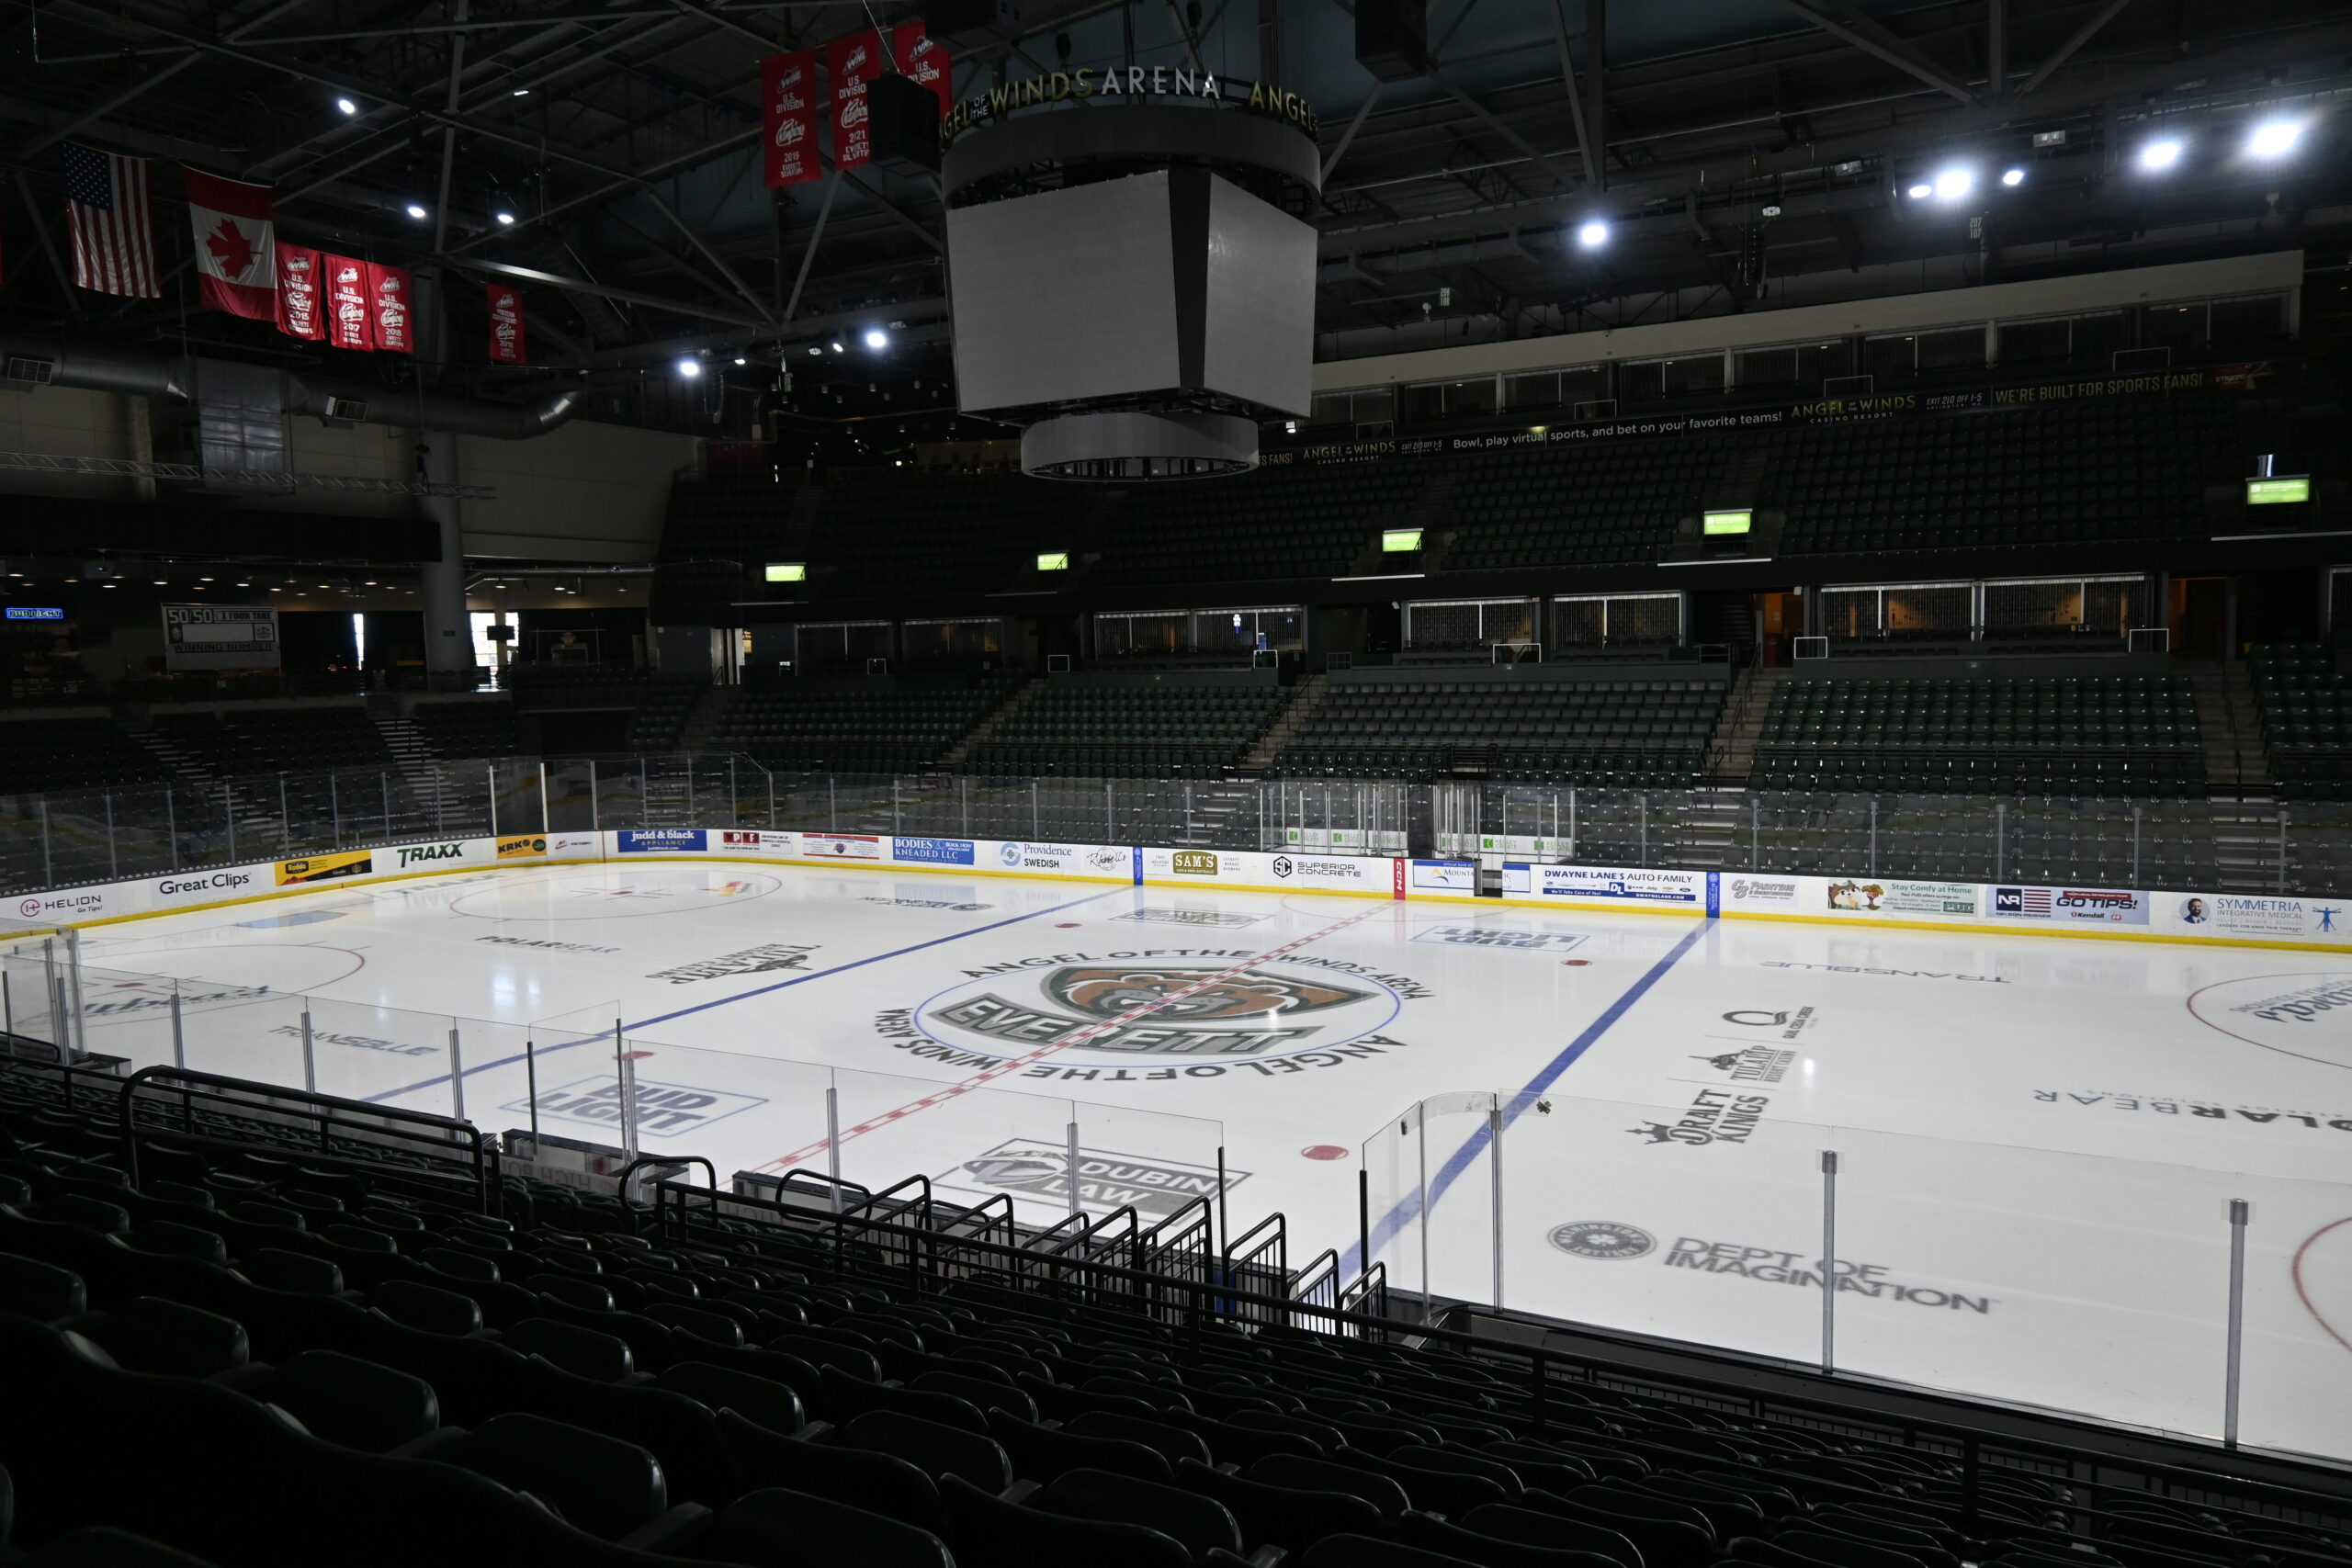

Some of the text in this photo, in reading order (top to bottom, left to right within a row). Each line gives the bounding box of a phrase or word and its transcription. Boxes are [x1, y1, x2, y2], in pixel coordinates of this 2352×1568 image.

[838, 83, 867, 99] DIVISIO
[972, 65, 1221, 119] OF THE WINDS ARENA
[776, 98, 804, 114] DIVISION
[784, 151, 799, 163] 2019
[335, 292, 364, 304] DIVISION
[379, 299, 405, 311] DIVISION
[343, 322, 360, 332] 2017
[1996, 386, 2036, 404] WE'RE
[2040, 383, 2075, 400] BUILT
[2078, 380, 2104, 396] FOR
[2108, 376, 2160, 395] SPORTS
[2163, 372, 2204, 390] FANS!
[1792, 395, 1917, 419] ANGEL WINDS
[1853, 412, 1894, 420] RESORT
[1453, 411, 1782, 449] Bowl, play virtual sports, and bet on your favorite teams!
[1303, 444, 1344, 461] ANGEL
[1353, 440, 1396, 457] WINDS
[168, 608, 213, 625] 50/50
[173, 642, 272, 653] WINNING NUMBER
[631, 829, 695, 841] judd & black
[895, 838, 933, 850] BODIES
[1023, 843, 1072, 856] Providence
[396, 840, 465, 868] TRAXX
[895, 849, 939, 858] KNEADED
[941, 851, 958, 860] LLC
[1175, 854, 1215, 868] SAM'S
[1023, 858, 1059, 868] SWEDISH
[1297, 862, 1355, 871] SUPERIOR
[1297, 869, 1361, 877] CONCRETE
[1444, 868, 1475, 878] MOUNTA
[1544, 870, 1693, 884] DWAYNE LANE'S AUTO FAMILY
[159, 871, 250, 895] Great Clips
[1892, 883, 1908, 892] Stay
[1910, 884, 1936, 893] Comfy
[1948, 886, 1972, 894] Home
[45, 895, 101, 910] HELION
[88, 905, 103, 913] Tips!
[2056, 897, 2086, 908] GO
[2088, 898, 2138, 909] TIPS!
[2217, 898, 2302, 912] SYMMETRIA
[2217, 909, 2303, 919] INTEGRATIVE MEDICAL
[1435, 928, 1577, 943] LIGHT
[1443, 935, 1549, 948] BUD
[961, 951, 1100, 979] ANGEL
[1277, 953, 1371, 982] WINDS
[1368, 968, 1436, 1001] ARENA
[1759, 961, 2011, 984] TRANSBLUE
[874, 1007, 918, 1039] ARENA
[941, 996, 1297, 1055] EVERETT
[895, 1040, 1002, 1071] WINDS
[1234, 1034, 1408, 1077] ANGEL
[1729, 1045, 1779, 1082] TULALIP
[1764, 1049, 1798, 1083] RESORT CASINO
[585, 1082, 718, 1111] BUD
[521, 1092, 707, 1130] LIGHT
[1667, 1089, 1733, 1146] DRAFT
[2033, 1089, 2352, 1132] OLARBEAR
[1714, 1094, 1770, 1145] KINGS
[1078, 1160, 1219, 1194] DUBIN
[1043, 1179, 1154, 1205] LAW
[1672, 1236, 1891, 1280] DEPT OF
[1663, 1251, 1991, 1315] IMAGINATION
